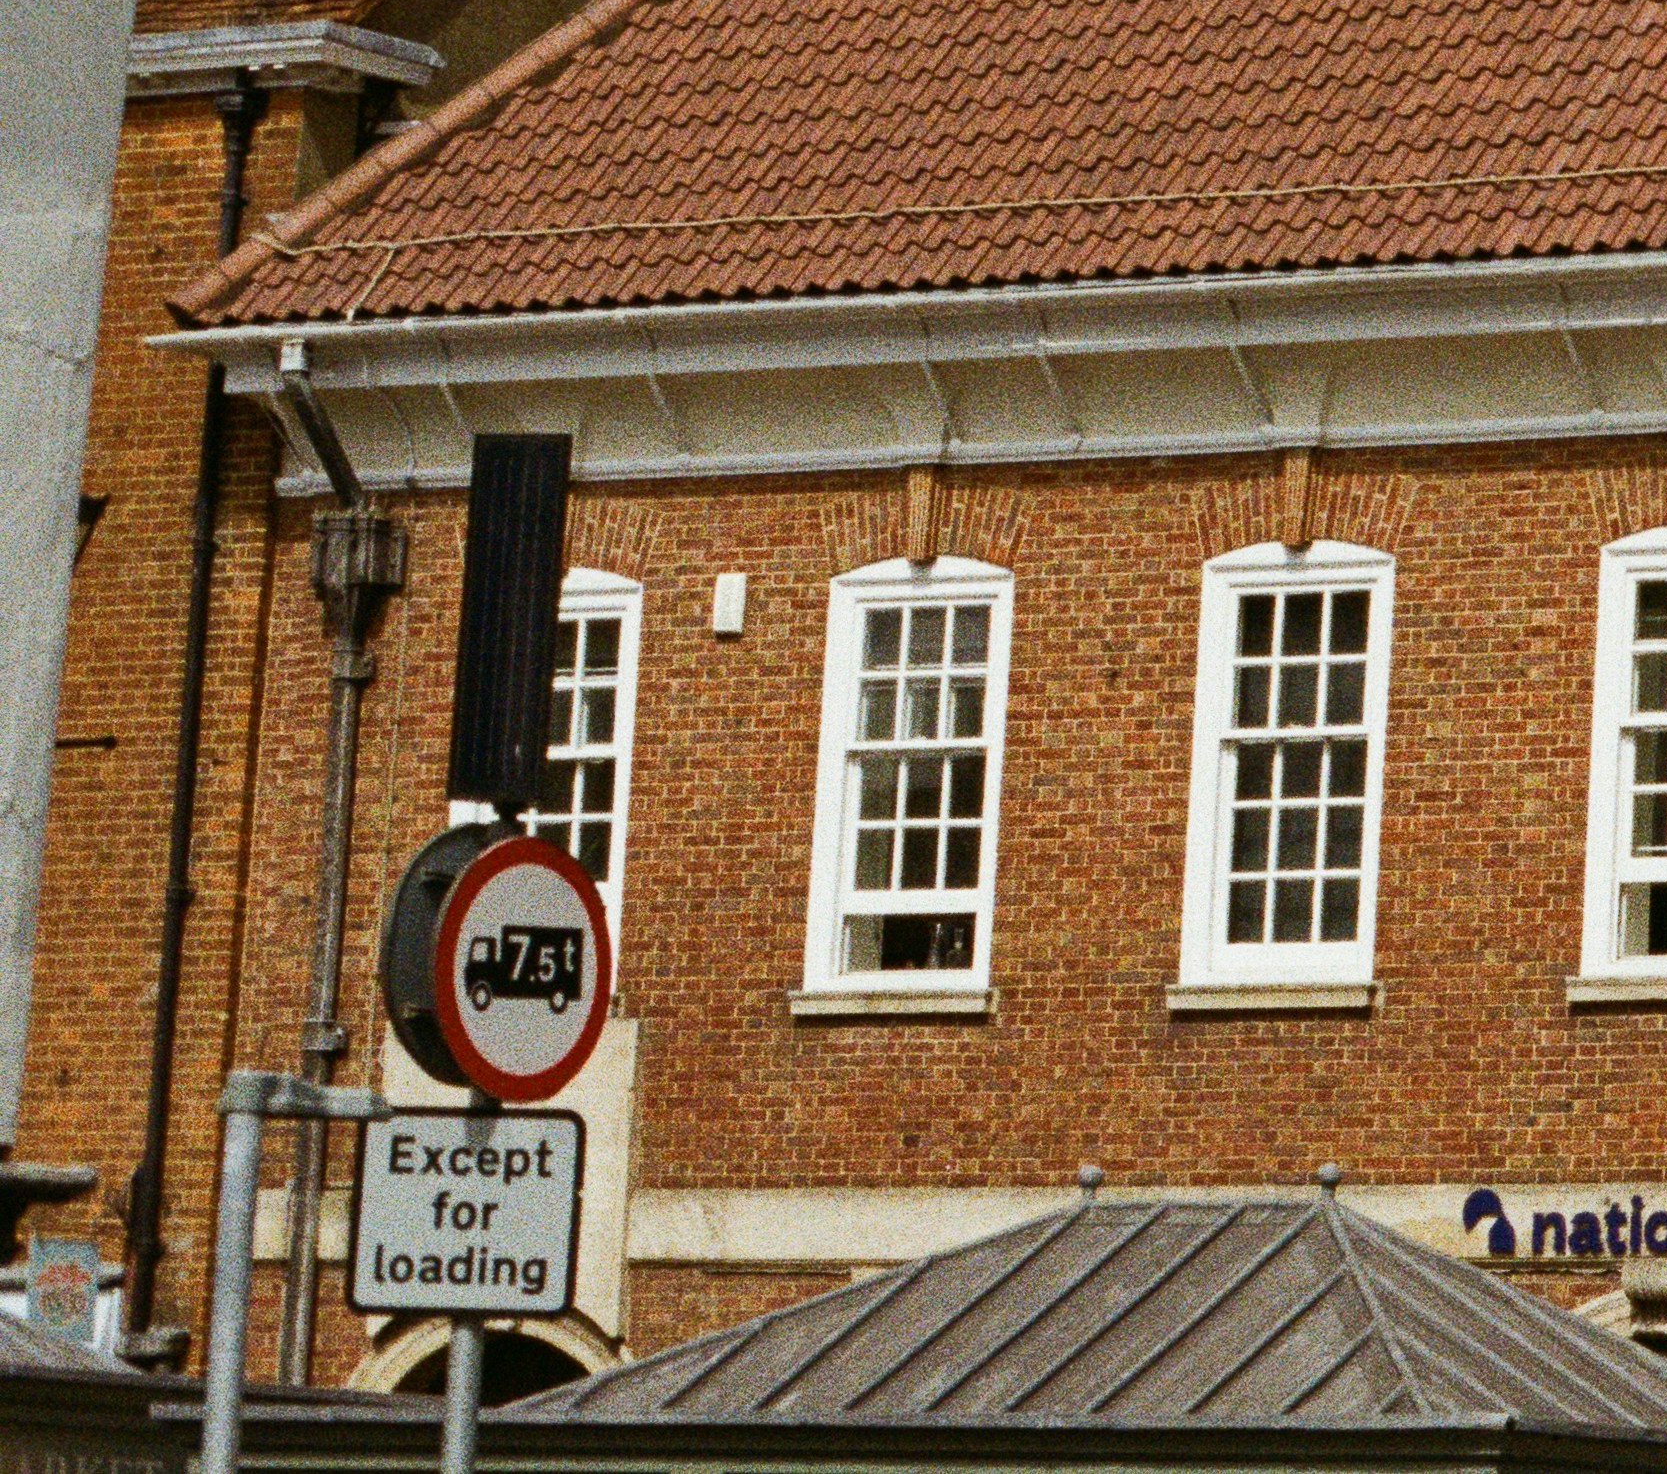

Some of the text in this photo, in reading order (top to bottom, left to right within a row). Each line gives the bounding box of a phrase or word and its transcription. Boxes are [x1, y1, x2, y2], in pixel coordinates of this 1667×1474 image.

[388, 1134, 555, 1185] Except
[432, 1190, 499, 1231] for
[374, 1243, 549, 1295] loading
